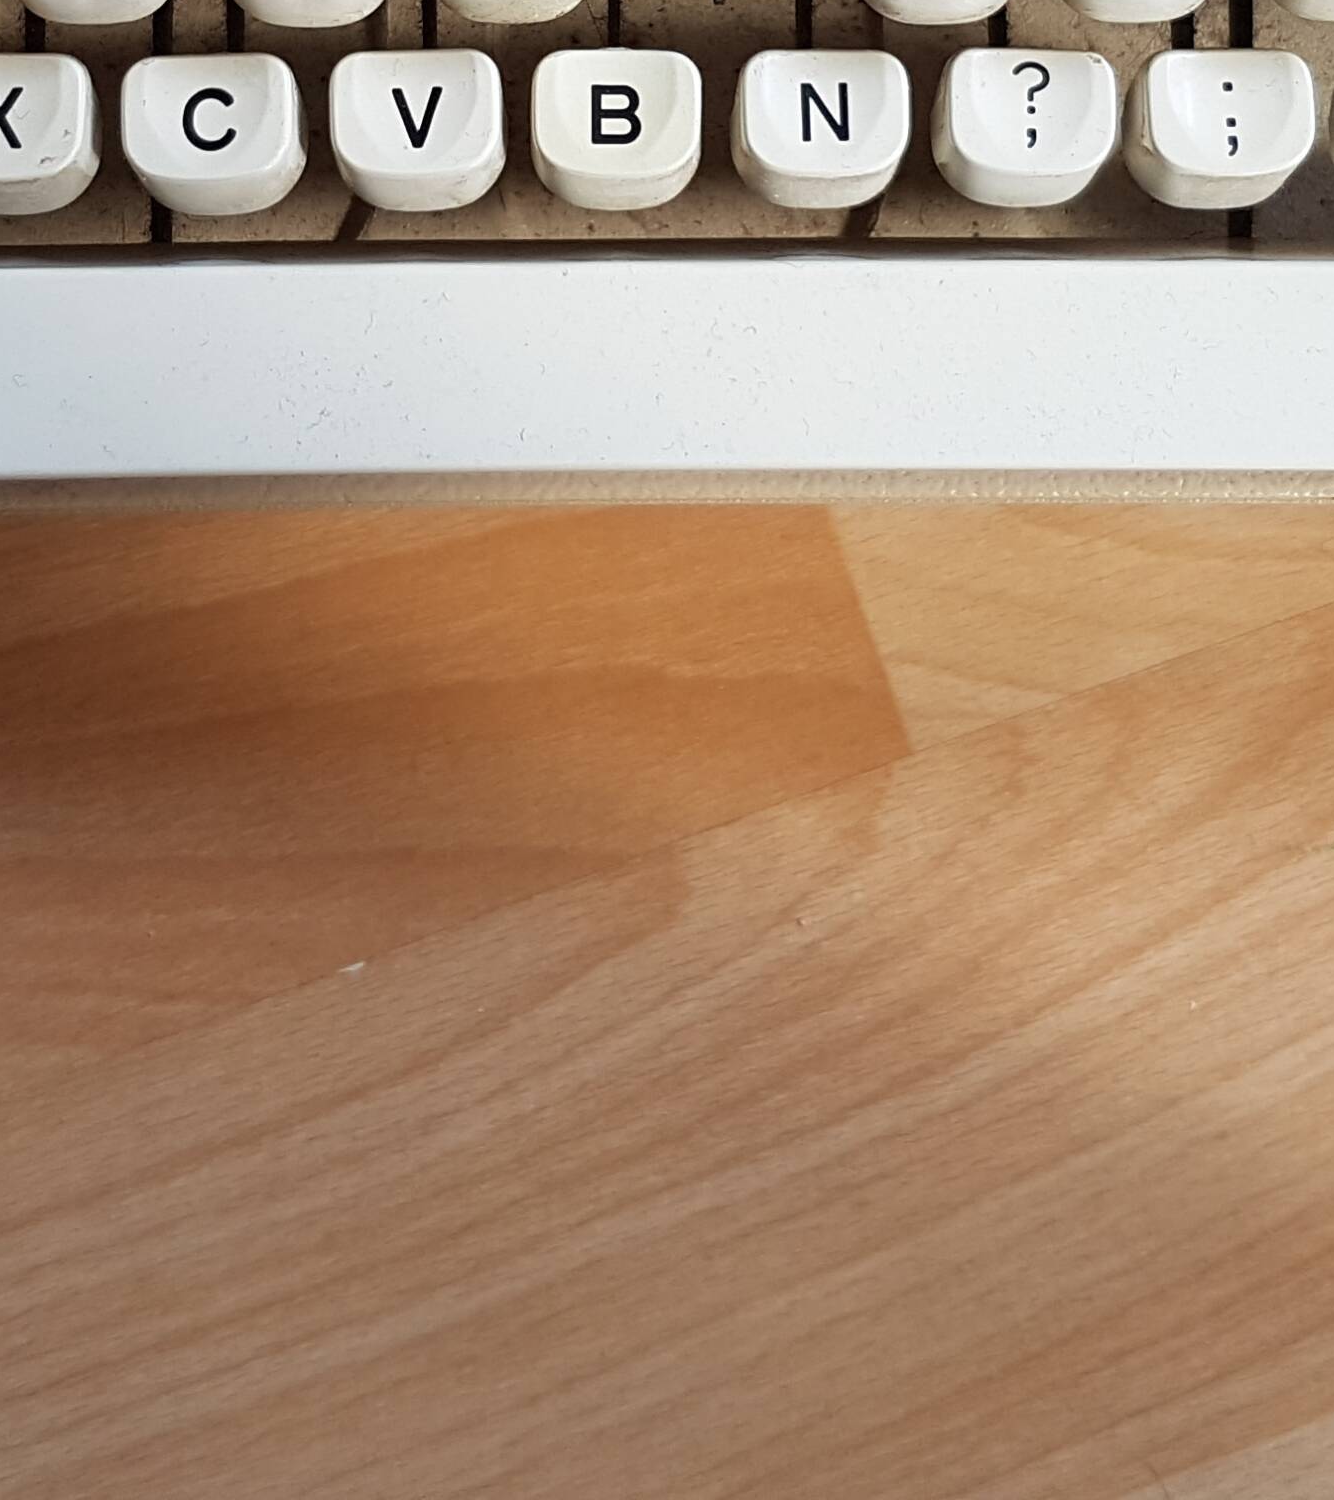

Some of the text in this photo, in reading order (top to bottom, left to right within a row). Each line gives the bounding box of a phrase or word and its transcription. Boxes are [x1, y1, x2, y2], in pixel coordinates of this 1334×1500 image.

[391, 86, 443, 149] V
[591, 84, 642, 145] B
[800, 82, 850, 142] N
[1012, 61, 1051, 115] ?
[182, 87, 237, 152] C
